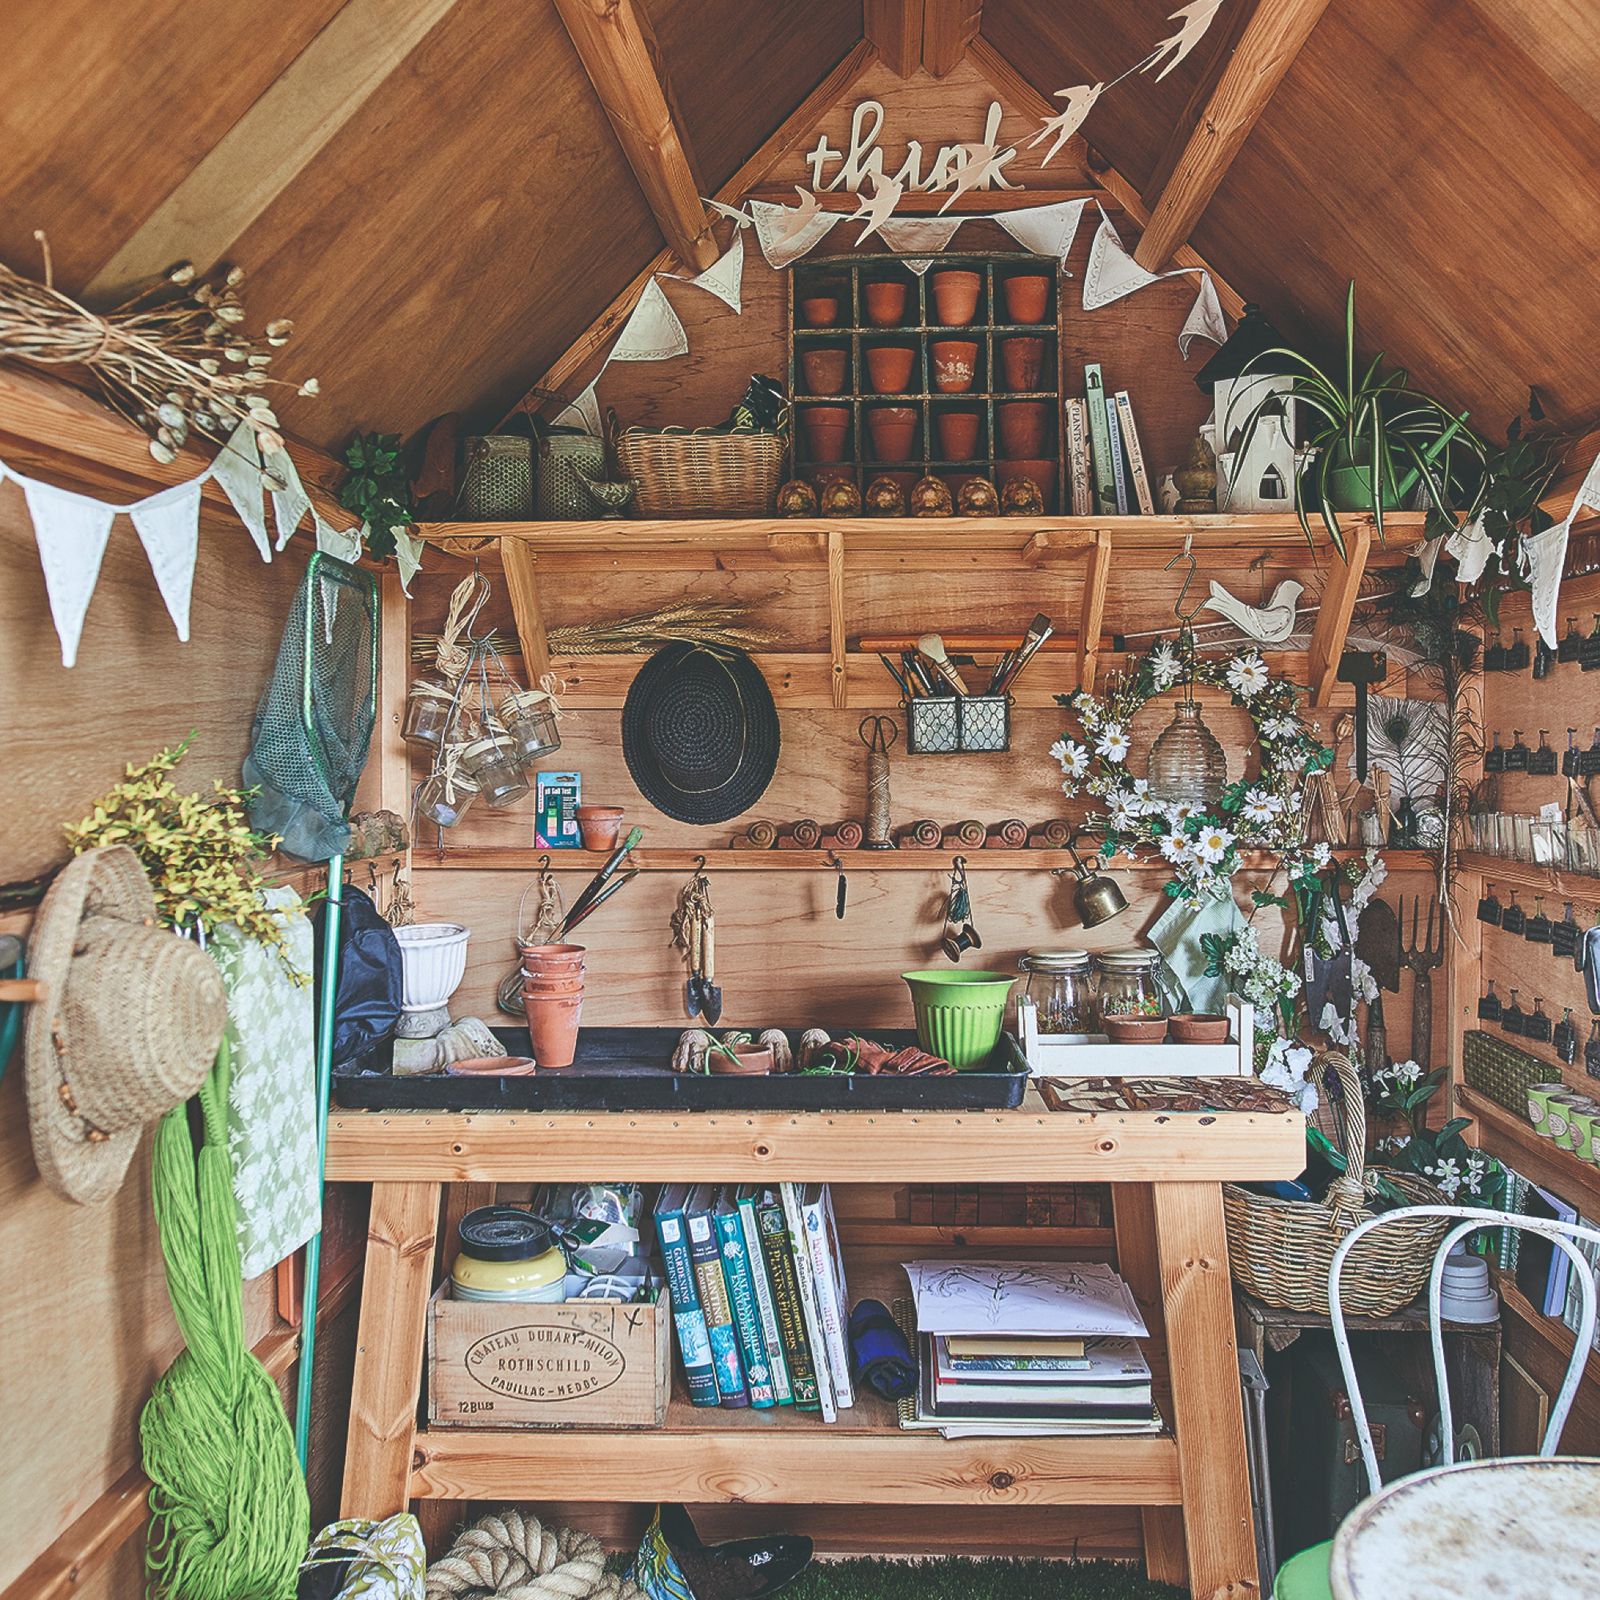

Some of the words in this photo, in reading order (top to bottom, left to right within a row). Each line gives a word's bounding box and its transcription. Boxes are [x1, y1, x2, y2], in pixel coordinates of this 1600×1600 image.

[806, 100, 1025, 193] think
[1071, 407, 1081, 442] PLANTS
[663, 1248, 681, 1305] TECHNIQUES
[672, 1246, 691, 1303] GARDENING
[735, 1258, 749, 1288] WHAT
[768, 1249, 787, 1290] PLANTS
[795, 1254, 812, 1301] Botanicum
[809, 1236, 828, 1276] botany
[823, 1305, 838, 1335] artist
[696, 1266, 713, 1325] COMBINATIONS
[704, 1264, 724, 1324] PLANTING
[729, 1274, 753, 1349] ENCYCLOPEDIA
[741, 1291, 755, 1324] PLANT
[776, 1290, 787, 1300] &
[747, 1325, 762, 1362] WHERE
[778, 1300, 798, 1351] FLOWERS
[469, 1332, 520, 1365] CHATEAU
[498, 1358, 591, 1372] ROTHSCHILD
[752, 1387, 770, 1399] DK
